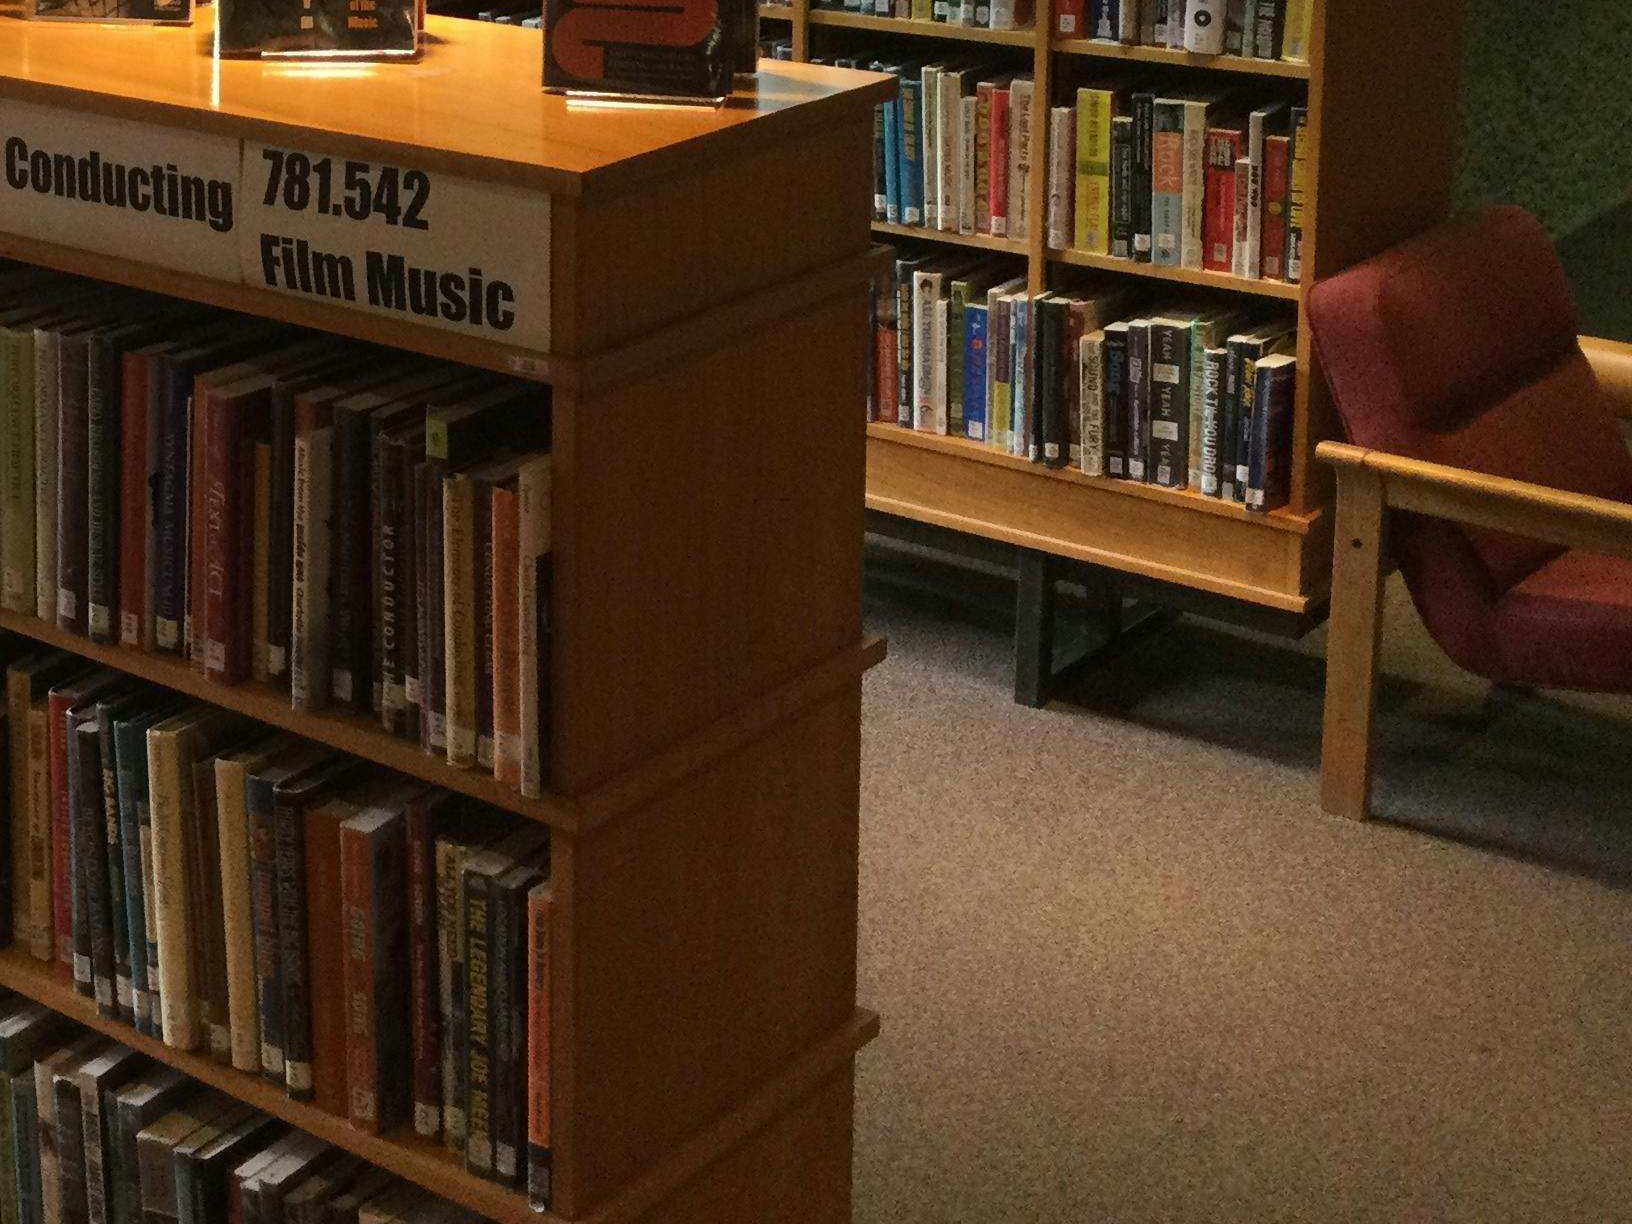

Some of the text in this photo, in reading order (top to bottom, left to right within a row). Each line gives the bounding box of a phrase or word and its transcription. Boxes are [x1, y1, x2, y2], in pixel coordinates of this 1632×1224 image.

[4, 135, 236, 234] Conducting
[261, 148, 432, 232] 781.542
[1158, 136, 1180, 187] Rock
[259, 233, 517, 333] Film Music
[1160, 329, 1174, 360] YEAH
[1203, 360, 1220, 395] ROCK
[1087, 355, 1100, 450] SOUND FURY
[1159, 386, 1173, 417] YEAH
[382, 525, 396, 653] CONDUCTOR
[103, 796, 119, 845] BANDS
[469, 898, 489, 1140] THE LEGENDARY JOE MEEK
